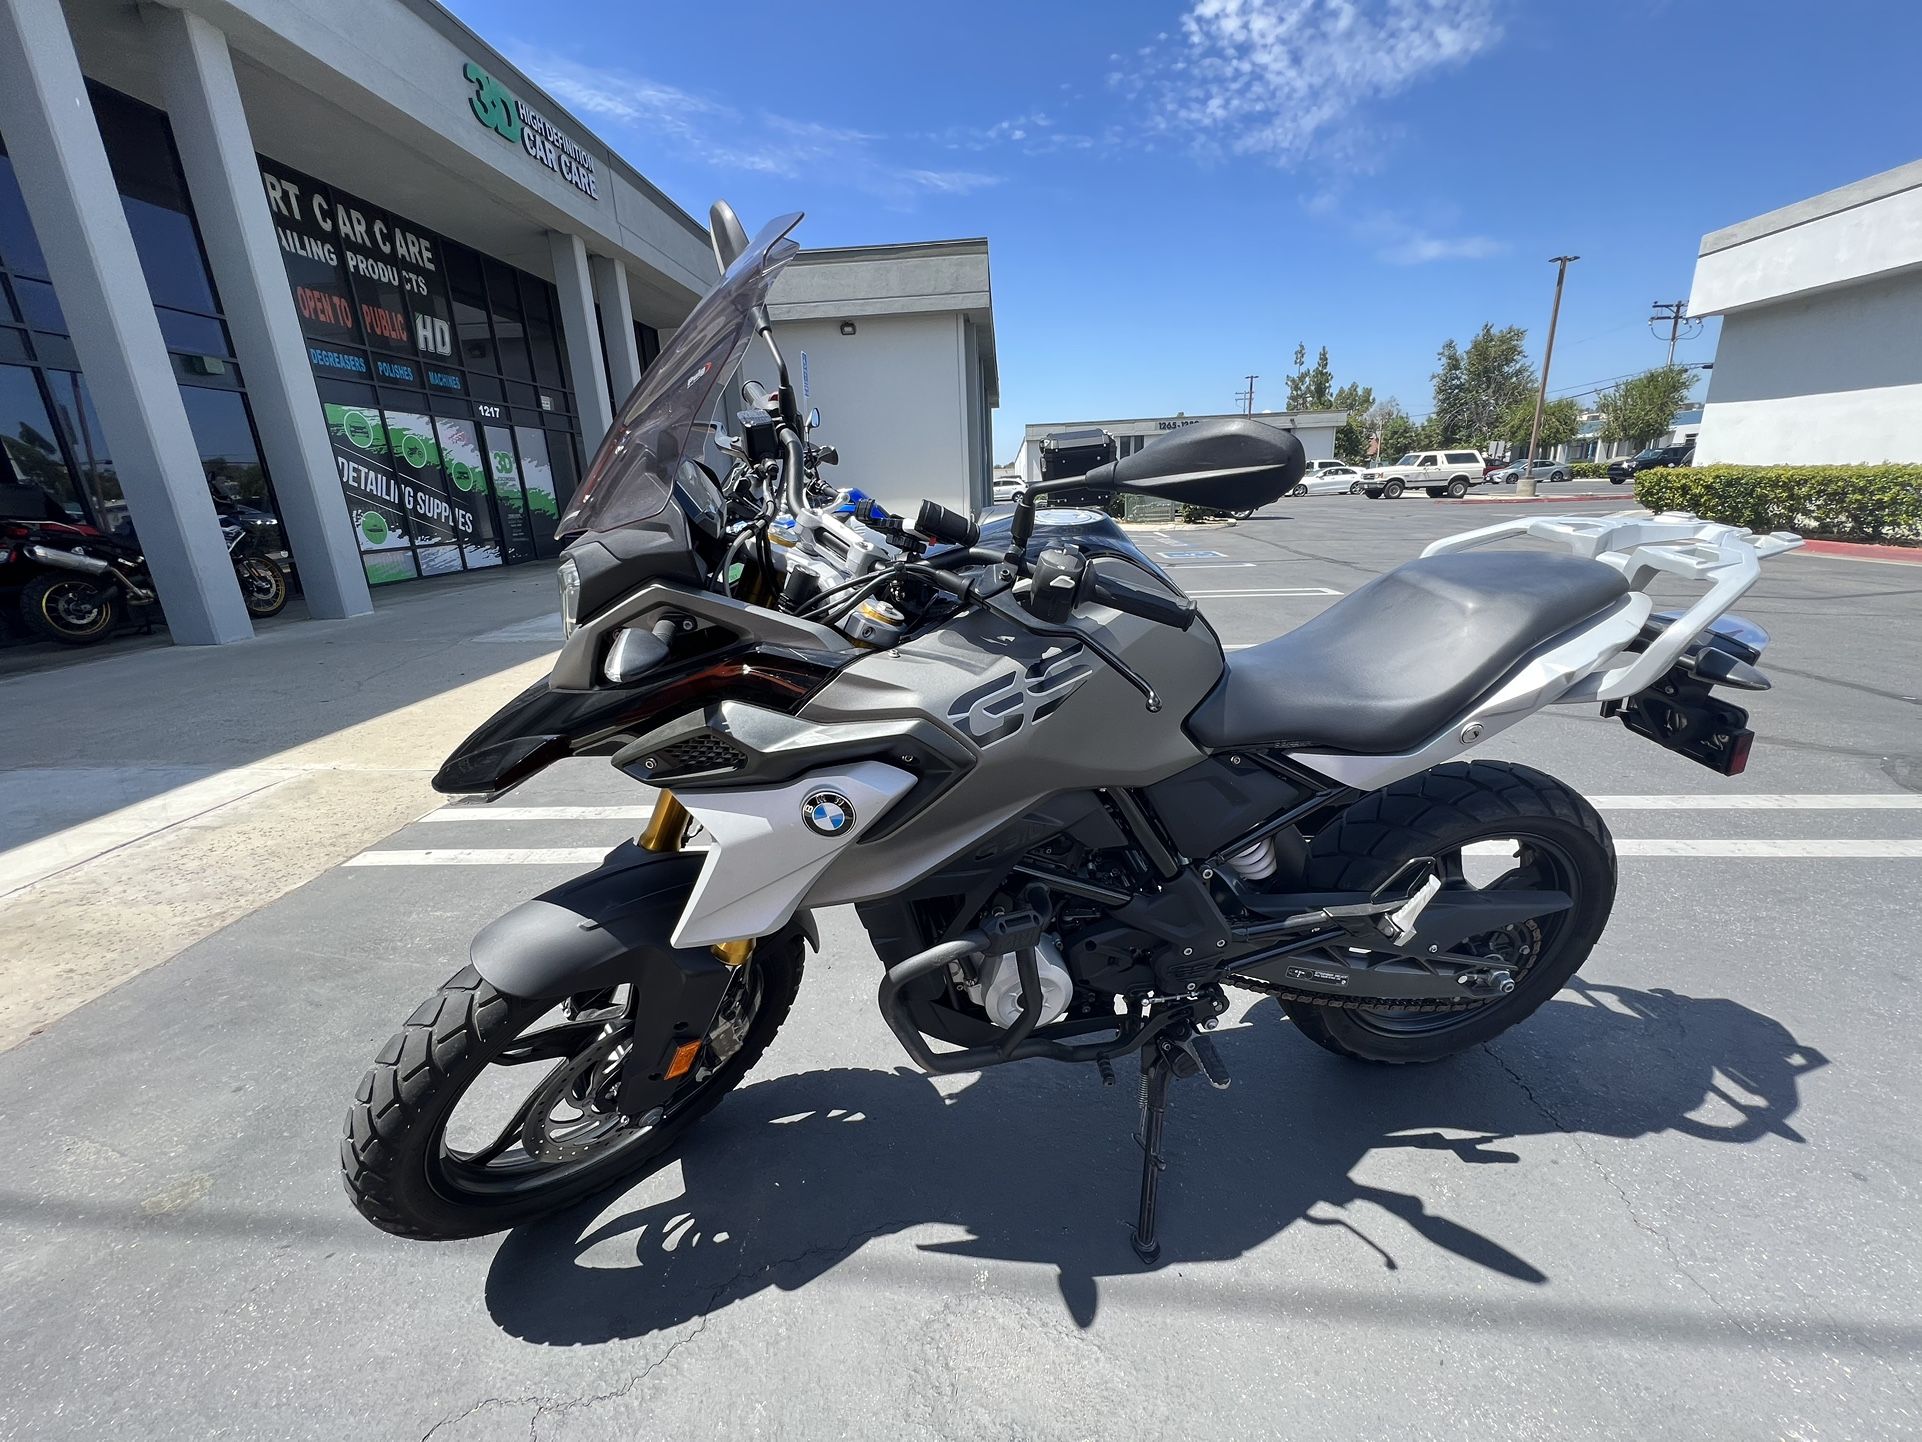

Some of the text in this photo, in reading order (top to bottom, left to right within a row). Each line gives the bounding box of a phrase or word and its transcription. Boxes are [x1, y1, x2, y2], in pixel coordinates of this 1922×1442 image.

[463, 63, 522, 143] 3D
[516, 100, 595, 174] HIGH DEFINITION
[521, 126, 599, 201] CAR CARE
[346, 250, 428, 296] PRODUCTS
[296, 286, 408, 342] OPEN TO PUBLIC
[415, 311, 452, 357] HD
[310, 348, 367, 373] DEGREASERS
[377, 361, 414, 382] POLISHES
[428, 371, 461, 390] MACHINES
[478, 404, 501, 419] 1217
[493, 451, 513, 475] 3D
